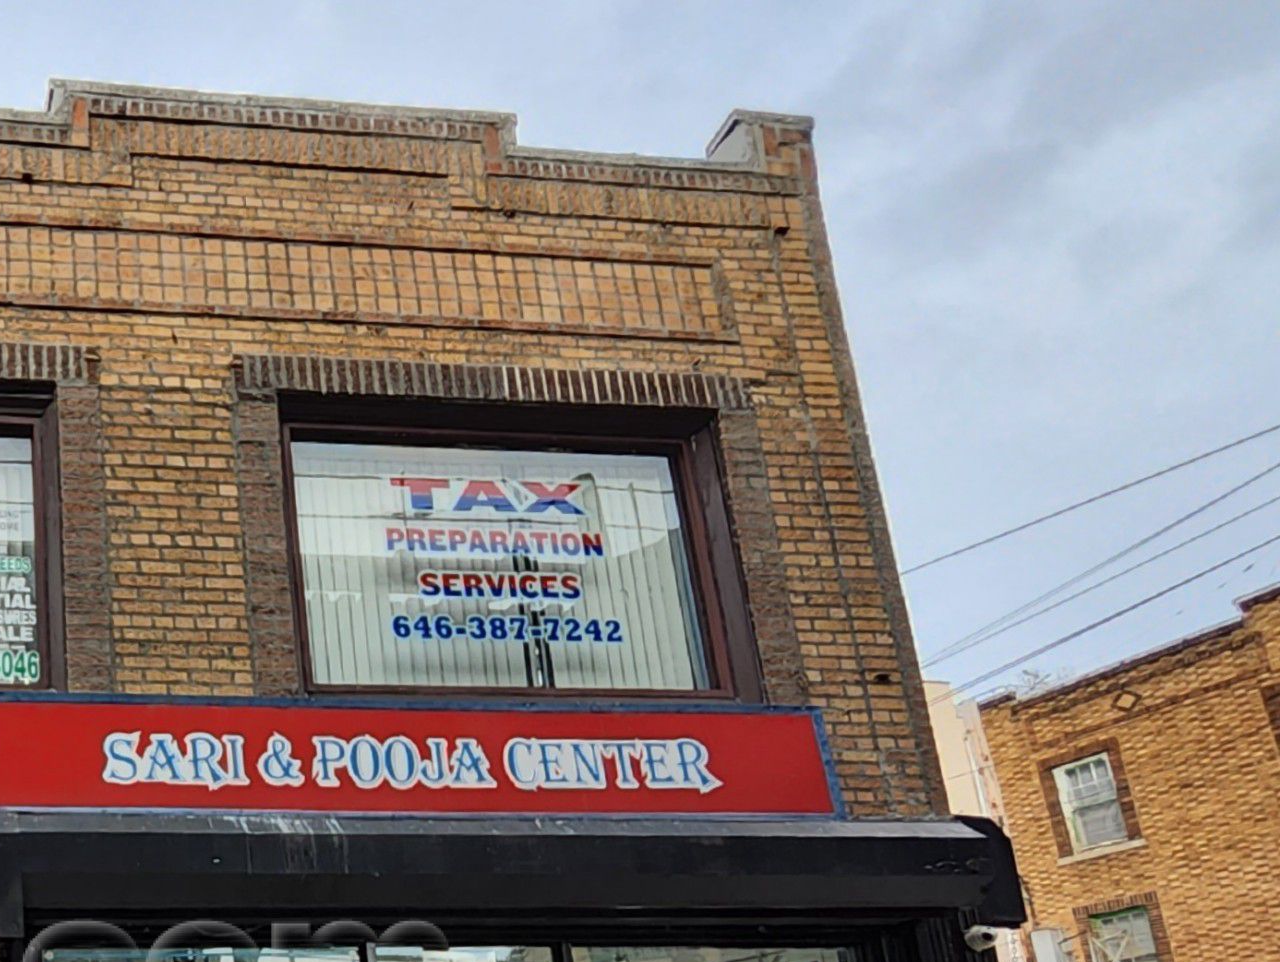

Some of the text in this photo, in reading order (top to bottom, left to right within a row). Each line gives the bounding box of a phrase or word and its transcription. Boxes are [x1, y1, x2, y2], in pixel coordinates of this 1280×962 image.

[389, 477, 585, 515] TAX
[386, 527, 604, 556] PREPARATION
[420, 572, 581, 600] SERVICES
[392, 615, 623, 643] 646-387-7242
[102, 731, 723, 793] SARI & POOJA CENTER
